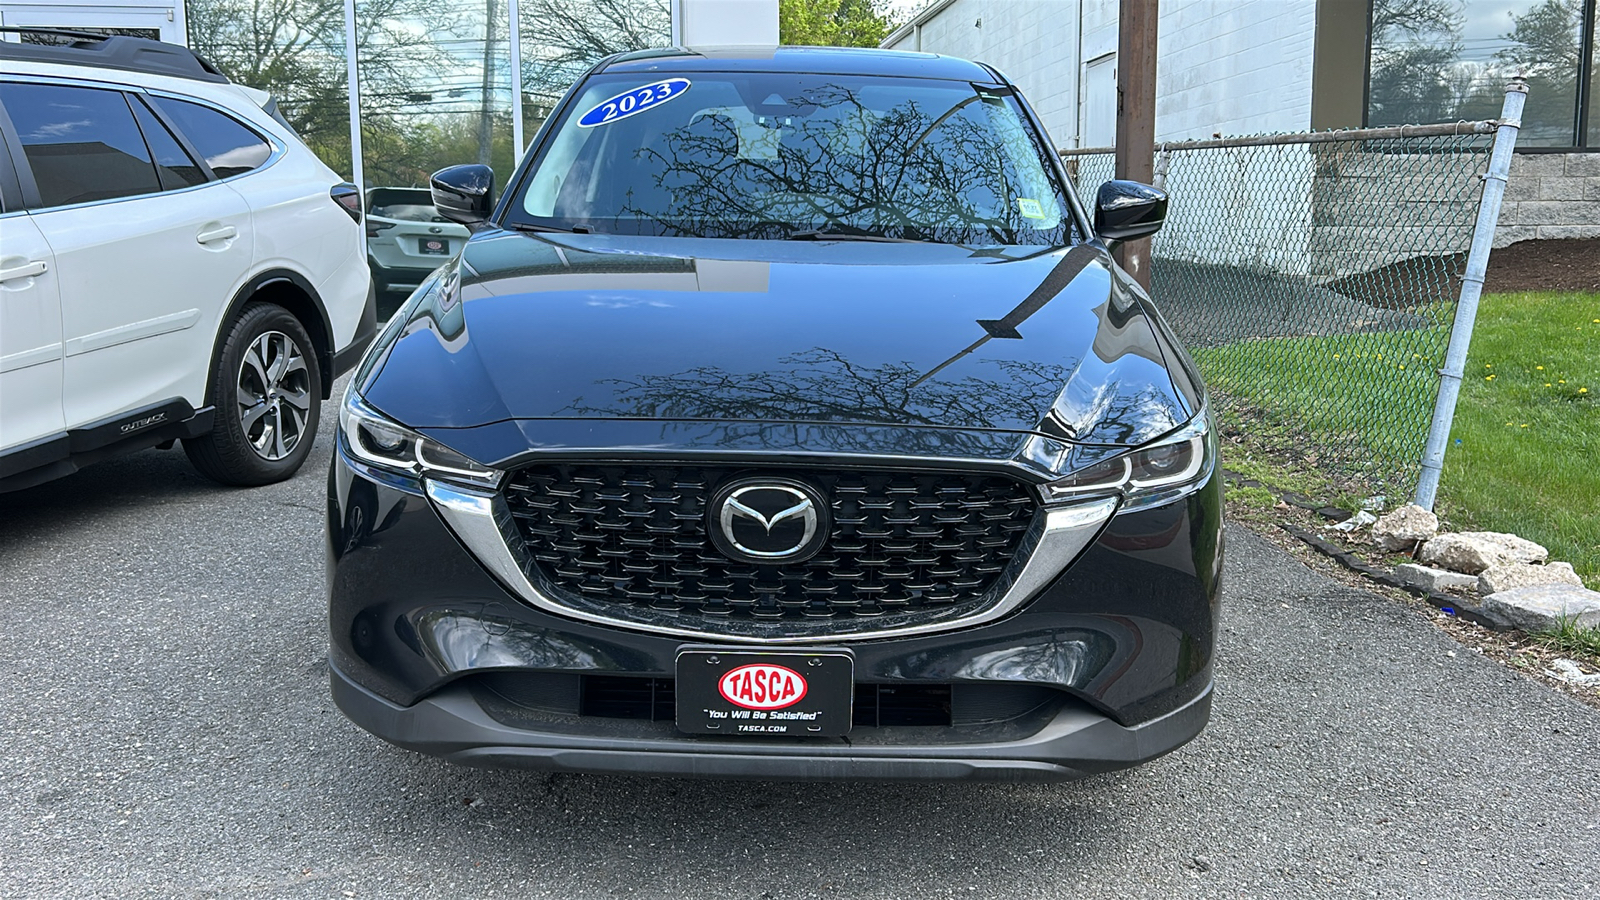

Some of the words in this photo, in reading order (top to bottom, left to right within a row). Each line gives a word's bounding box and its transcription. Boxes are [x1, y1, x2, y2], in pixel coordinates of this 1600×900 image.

[602, 83, 672, 121] 2023
[120, 412, 167, 432] OUTBACK
[729, 669, 796, 703] TASCA
[731, 710, 750, 719] Will
[752, 711, 767, 720] Be
